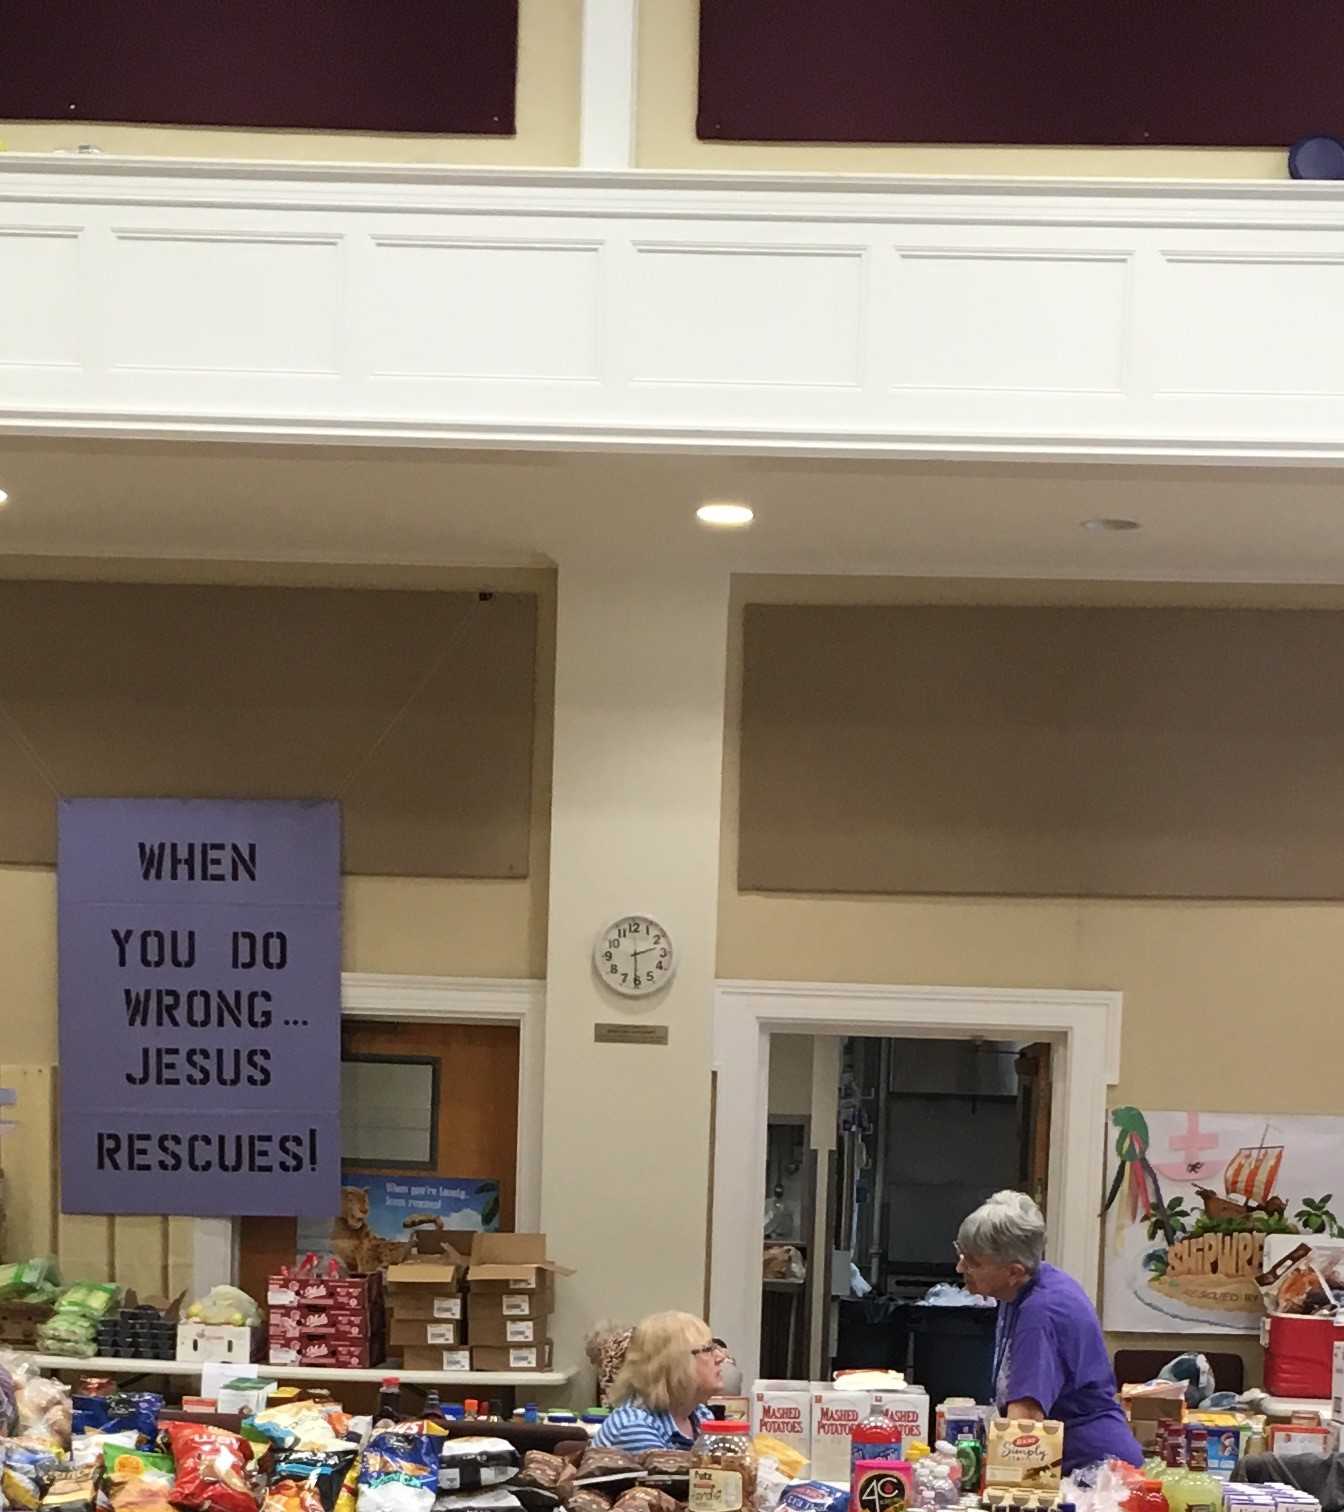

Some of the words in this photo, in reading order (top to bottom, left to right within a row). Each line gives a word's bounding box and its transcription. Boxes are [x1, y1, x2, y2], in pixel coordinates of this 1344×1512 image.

[138, 842, 257, 881] WHEN
[618, 928, 627, 938] 11
[628, 922, 640, 933] 12
[645, 925, 650, 935] 1
[608, 938, 620, 949] 10
[653, 934, 661, 945] 2
[111, 930, 195, 969] YOU
[232, 931, 288, 969] DO
[659, 947, 668, 958] 3
[604, 951, 613, 961] 9
[610, 964, 618, 974] 8
[655, 960, 663, 970] 4
[621, 972, 629, 983] 7
[646, 971, 654, 981] 5
[125, 1048, 272, 1086] JESUS
[97, 1128, 318, 1172] RESCUES!
[762, 1405, 801, 1420] MASHED
[820, 1407, 858, 1422] MASHED
[759, 1419, 804, 1434] POTATOES
[817, 1421, 855, 1436] POTATO
[1001, 1441, 1048, 1461] Simply
